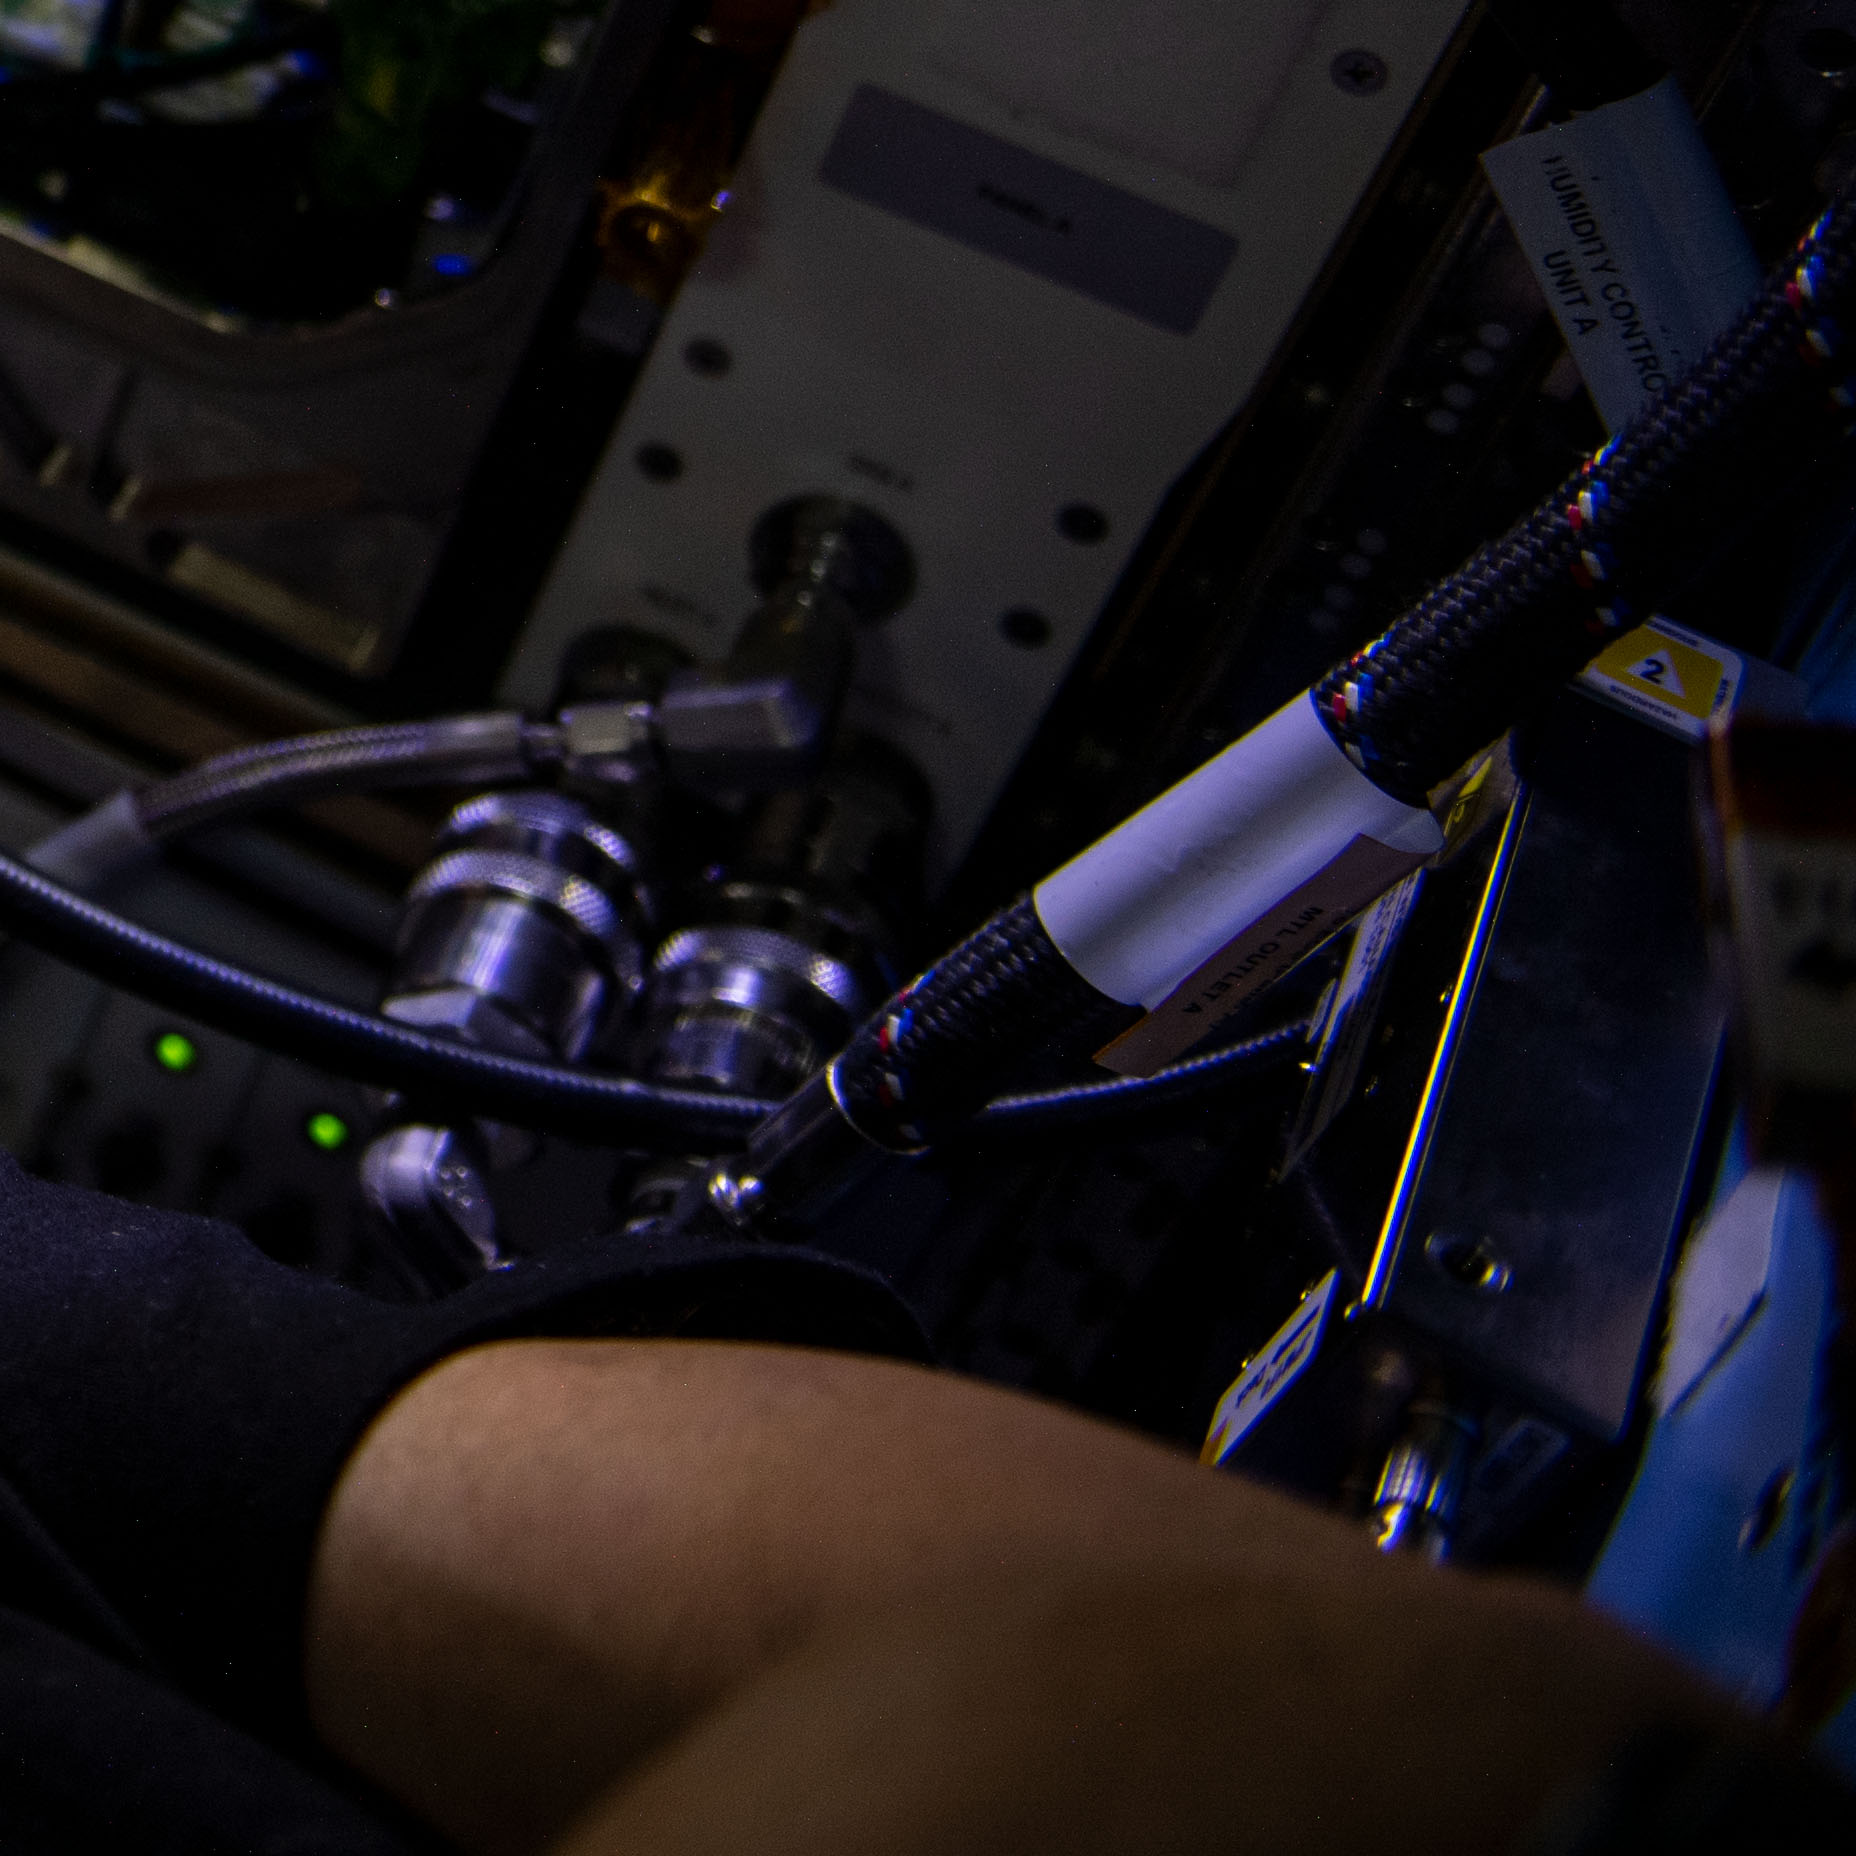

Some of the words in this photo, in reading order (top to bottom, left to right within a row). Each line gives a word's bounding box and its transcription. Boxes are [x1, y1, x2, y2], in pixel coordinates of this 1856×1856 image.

[1544, 250, 1591, 307] UNIT
[1573, 318, 1598, 336] A
[1601, 282, 1667, 393] CONTRO
[1640, 658, 1665, 685] 2
[1276, 907, 1324, 937] MTL
[1203, 942, 1279, 1000] OUTLET
[1183, 1003, 1203, 1014] A
